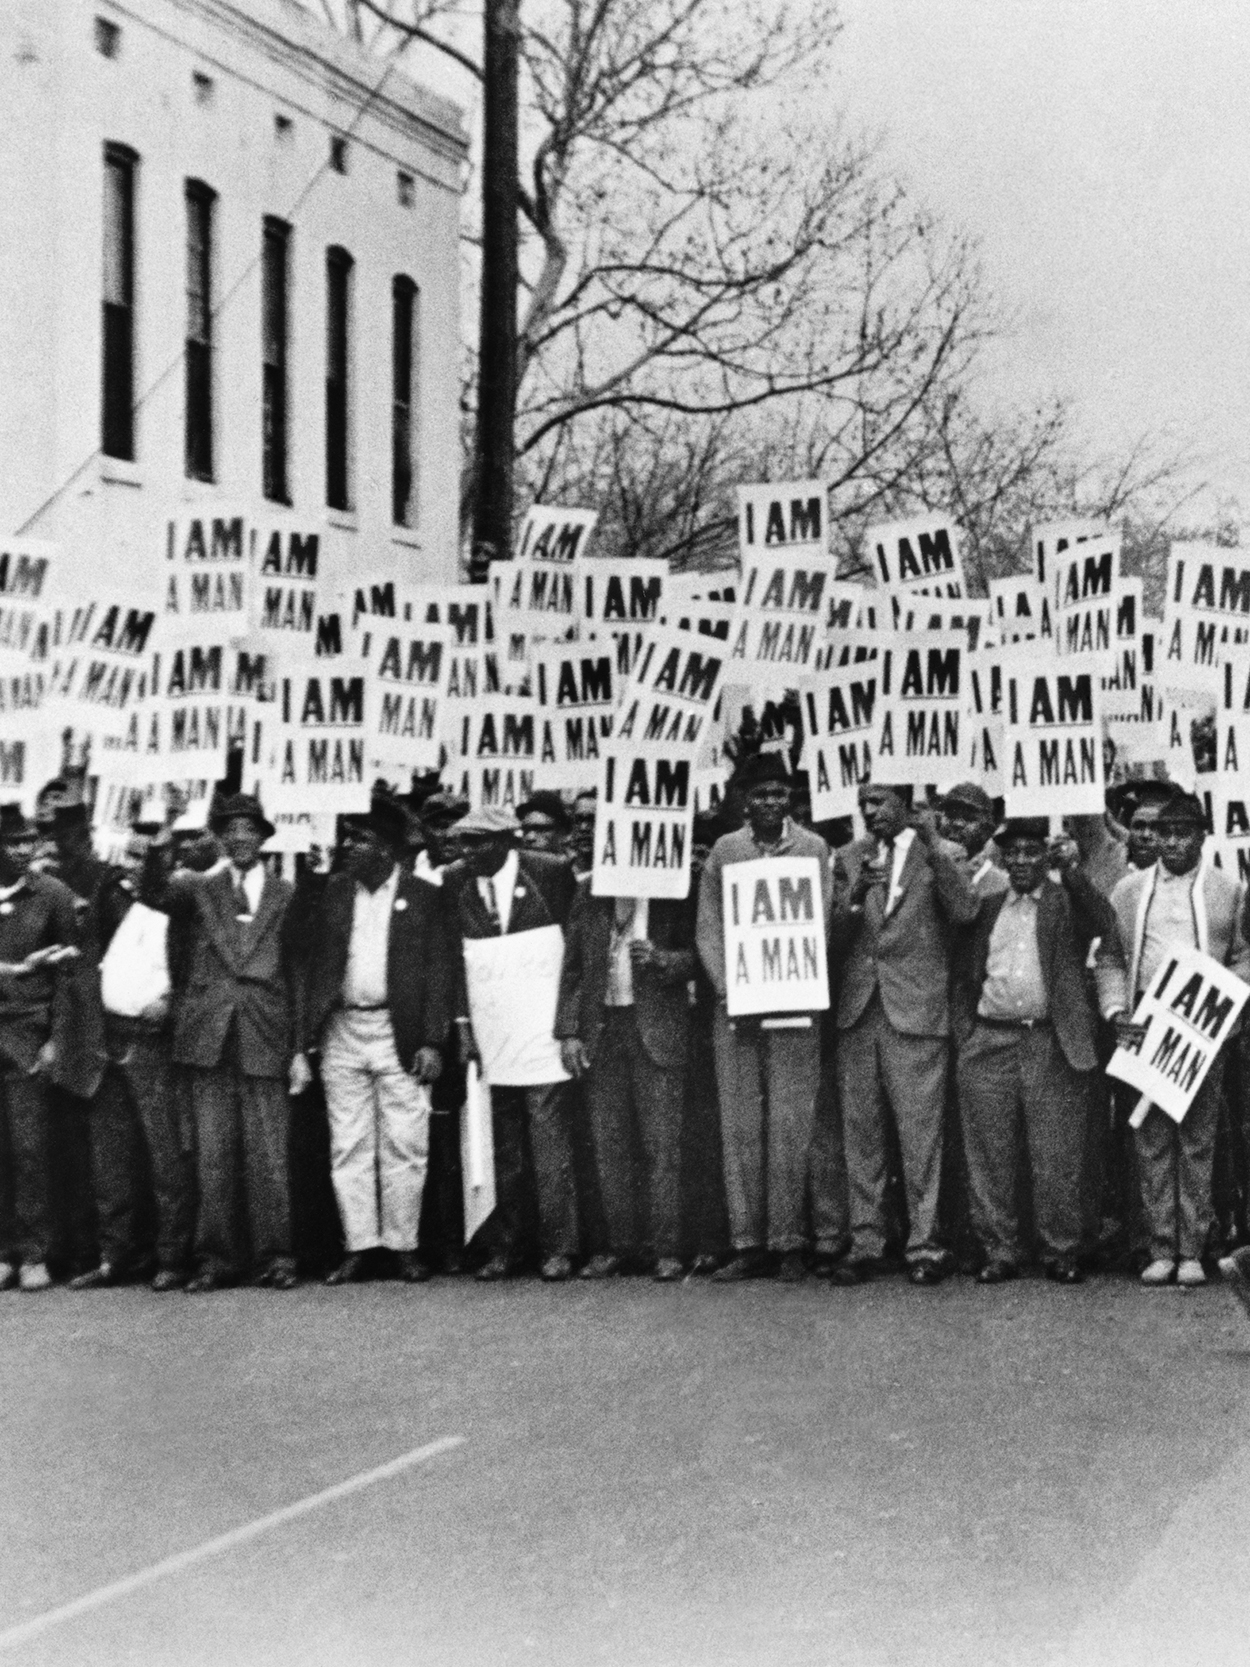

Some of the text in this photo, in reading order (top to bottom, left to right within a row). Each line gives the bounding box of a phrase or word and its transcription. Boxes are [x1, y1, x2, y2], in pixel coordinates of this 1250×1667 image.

[167, 517, 244, 560] I AM
[531, 523, 585, 564] AM
[746, 496, 822, 547] I AM
[261, 530, 320, 580] AM
[876, 528, 955, 584] I AM
[1037, 541, 1045, 583] I
[1065, 552, 1113, 602] AM
[166, 572, 243, 613] A MAN
[531, 570, 573, 614] MAN
[586, 576, 593, 618] I
[603, 575, 662, 622] AM
[743, 567, 758, 606] I
[761, 568, 828, 613] AM
[1173, 560, 1185, 603] I
[378, 636, 444, 684] AM
[731, 619, 750, 660] A
[756, 621, 816, 665] MAN
[1167, 618, 1182, 661] A
[151, 645, 223, 696] I AM
[538, 656, 613, 706] I AM
[637, 641, 723, 702] I AM
[882, 650, 892, 695] I
[900, 648, 961, 699] AM
[1225, 663, 1232, 709] I
[283, 676, 365, 724] I AM
[381, 692, 437, 740] MAN
[618, 698, 703, 743] A MAN
[805, 691, 819, 736] I
[1009, 674, 1094, 725] I AM
[147, 707, 220, 753] A MAN
[461, 712, 535, 757] I AM
[541, 720, 556, 763] A
[878, 710, 959, 756] A MAN
[1224, 725, 1239, 772] A
[282, 738, 364, 783] A MAN
[605, 756, 691, 808] I AM
[817, 749, 831, 793] A
[1012, 737, 1096, 787] A MAN
[601, 819, 686, 869] A MAN
[731, 876, 814, 926] I AM
[736, 936, 818, 984] A MAN
[1153, 958, 1179, 1000] I
[1170, 972, 1235, 1040] AM
[1149, 1026, 1206, 1093] MAN
